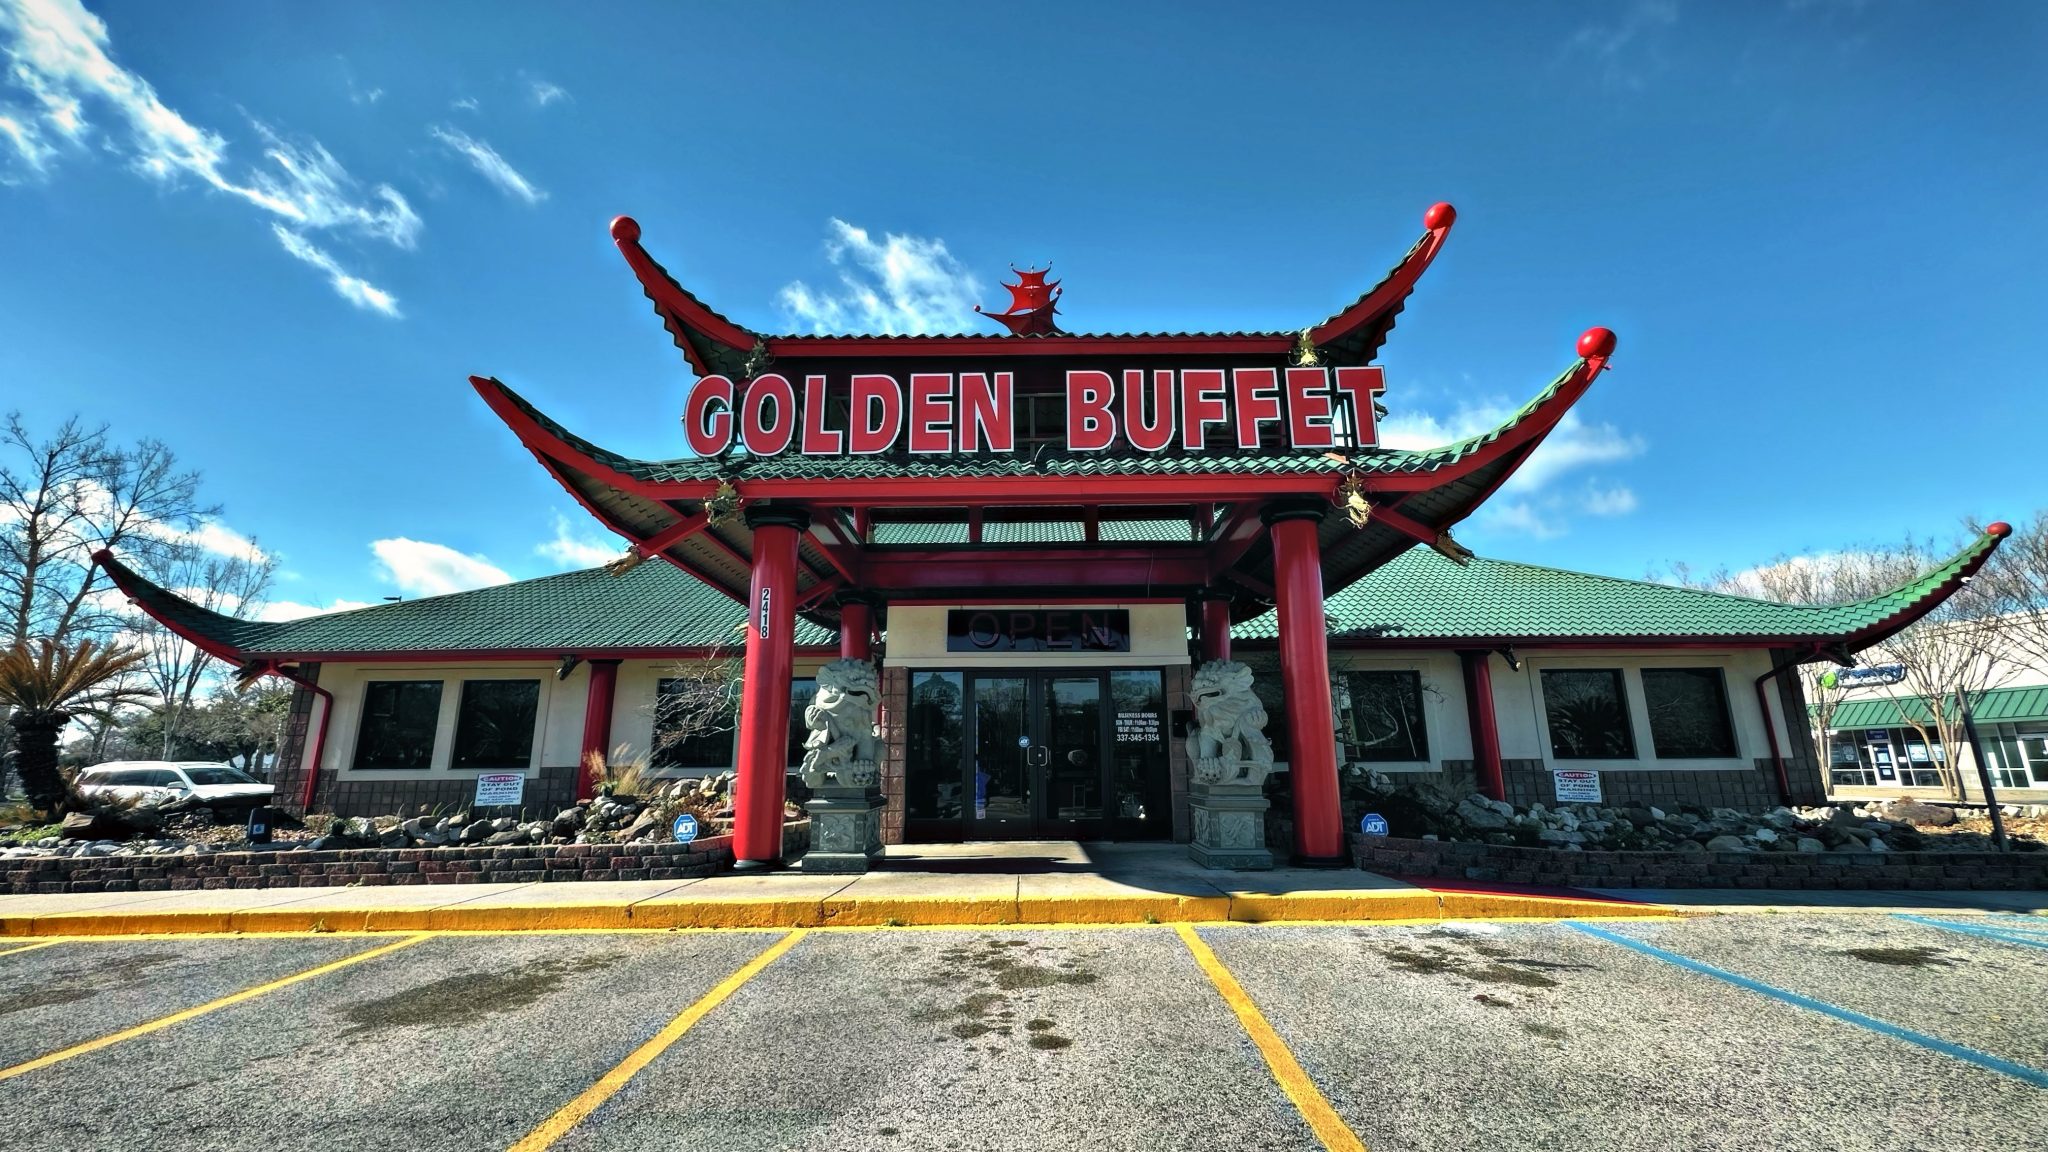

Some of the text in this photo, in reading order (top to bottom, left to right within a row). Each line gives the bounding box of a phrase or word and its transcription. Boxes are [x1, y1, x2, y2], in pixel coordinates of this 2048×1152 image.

[684, 365, 1387, 458] GOLDEN BUFFET
[761, 588, 770, 638] 2418
[968, 611, 1110, 645] OPEN
[1116, 733, 1160, 742] 337-345-1354
[676, 821, 696, 834] ADT
[1366, 821, 1385, 833] ADT
